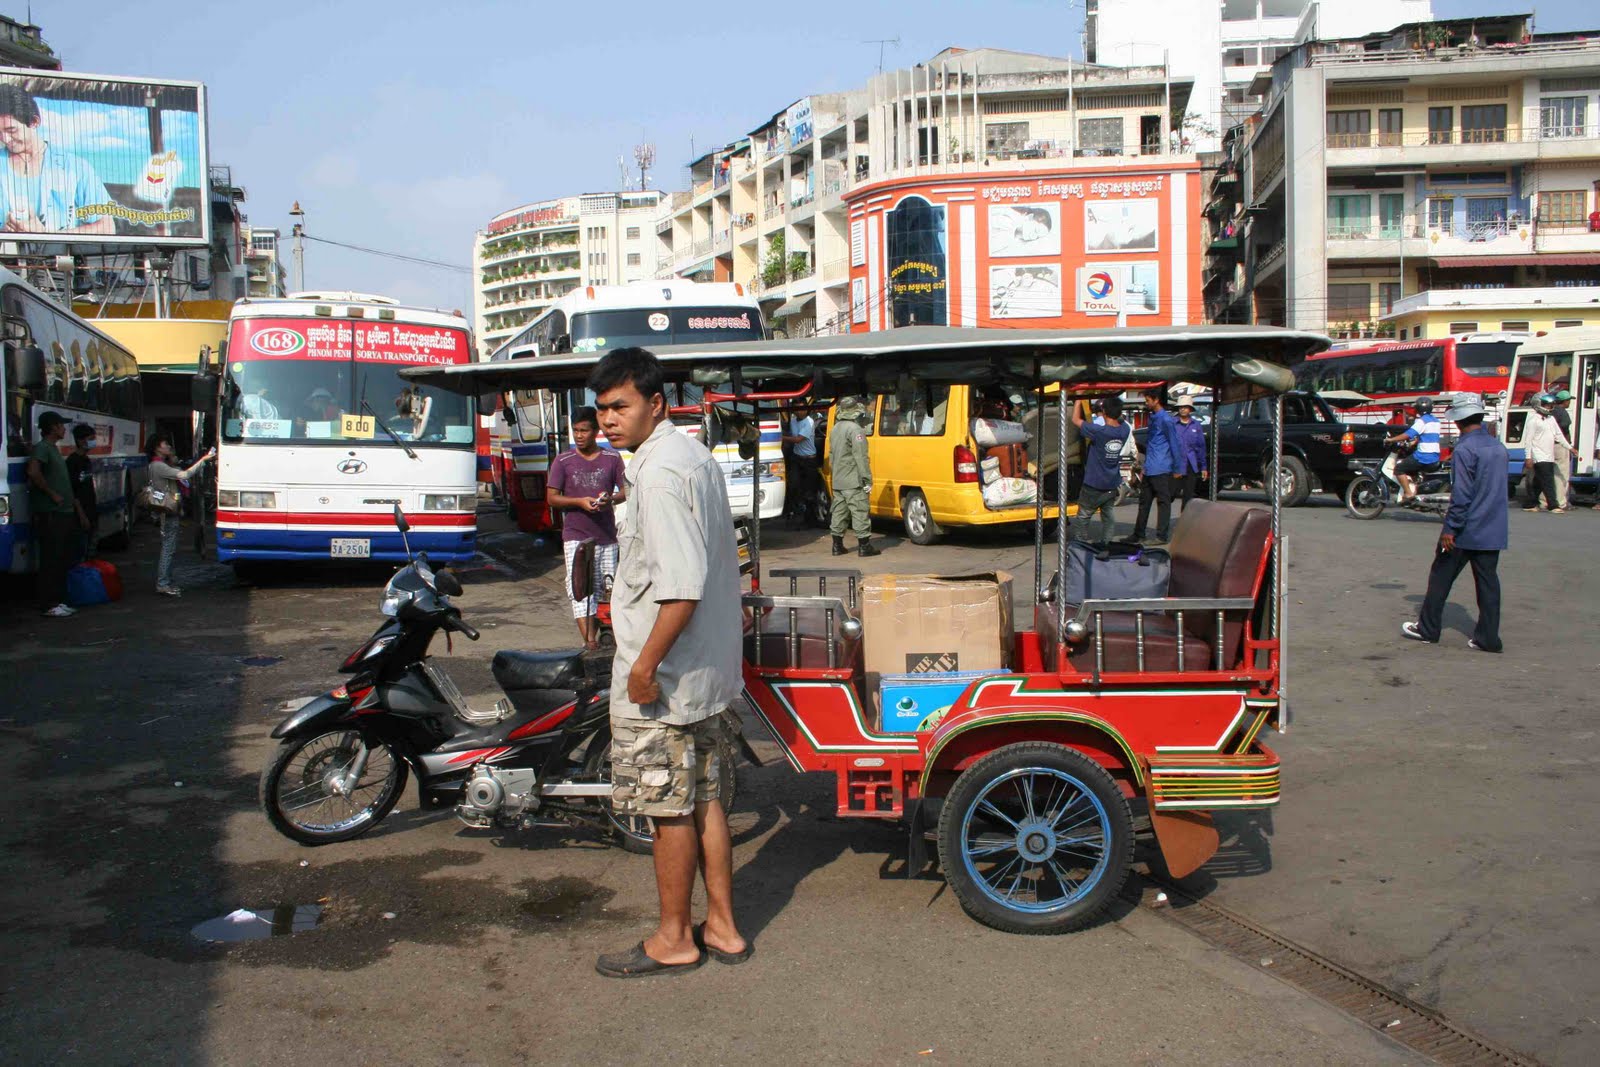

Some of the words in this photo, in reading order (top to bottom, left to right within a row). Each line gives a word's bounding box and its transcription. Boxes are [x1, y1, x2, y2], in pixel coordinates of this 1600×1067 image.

[1083, 301, 1117, 310] TOTAL
[652, 317, 666, 326] 22
[262, 333, 293, 349] 168
[307, 349, 332, 358] PHNOM
[333, 349, 352, 358] PENH
[357, 351, 382, 361] SORYA
[383, 352, 429, 363] TRANSPORT
